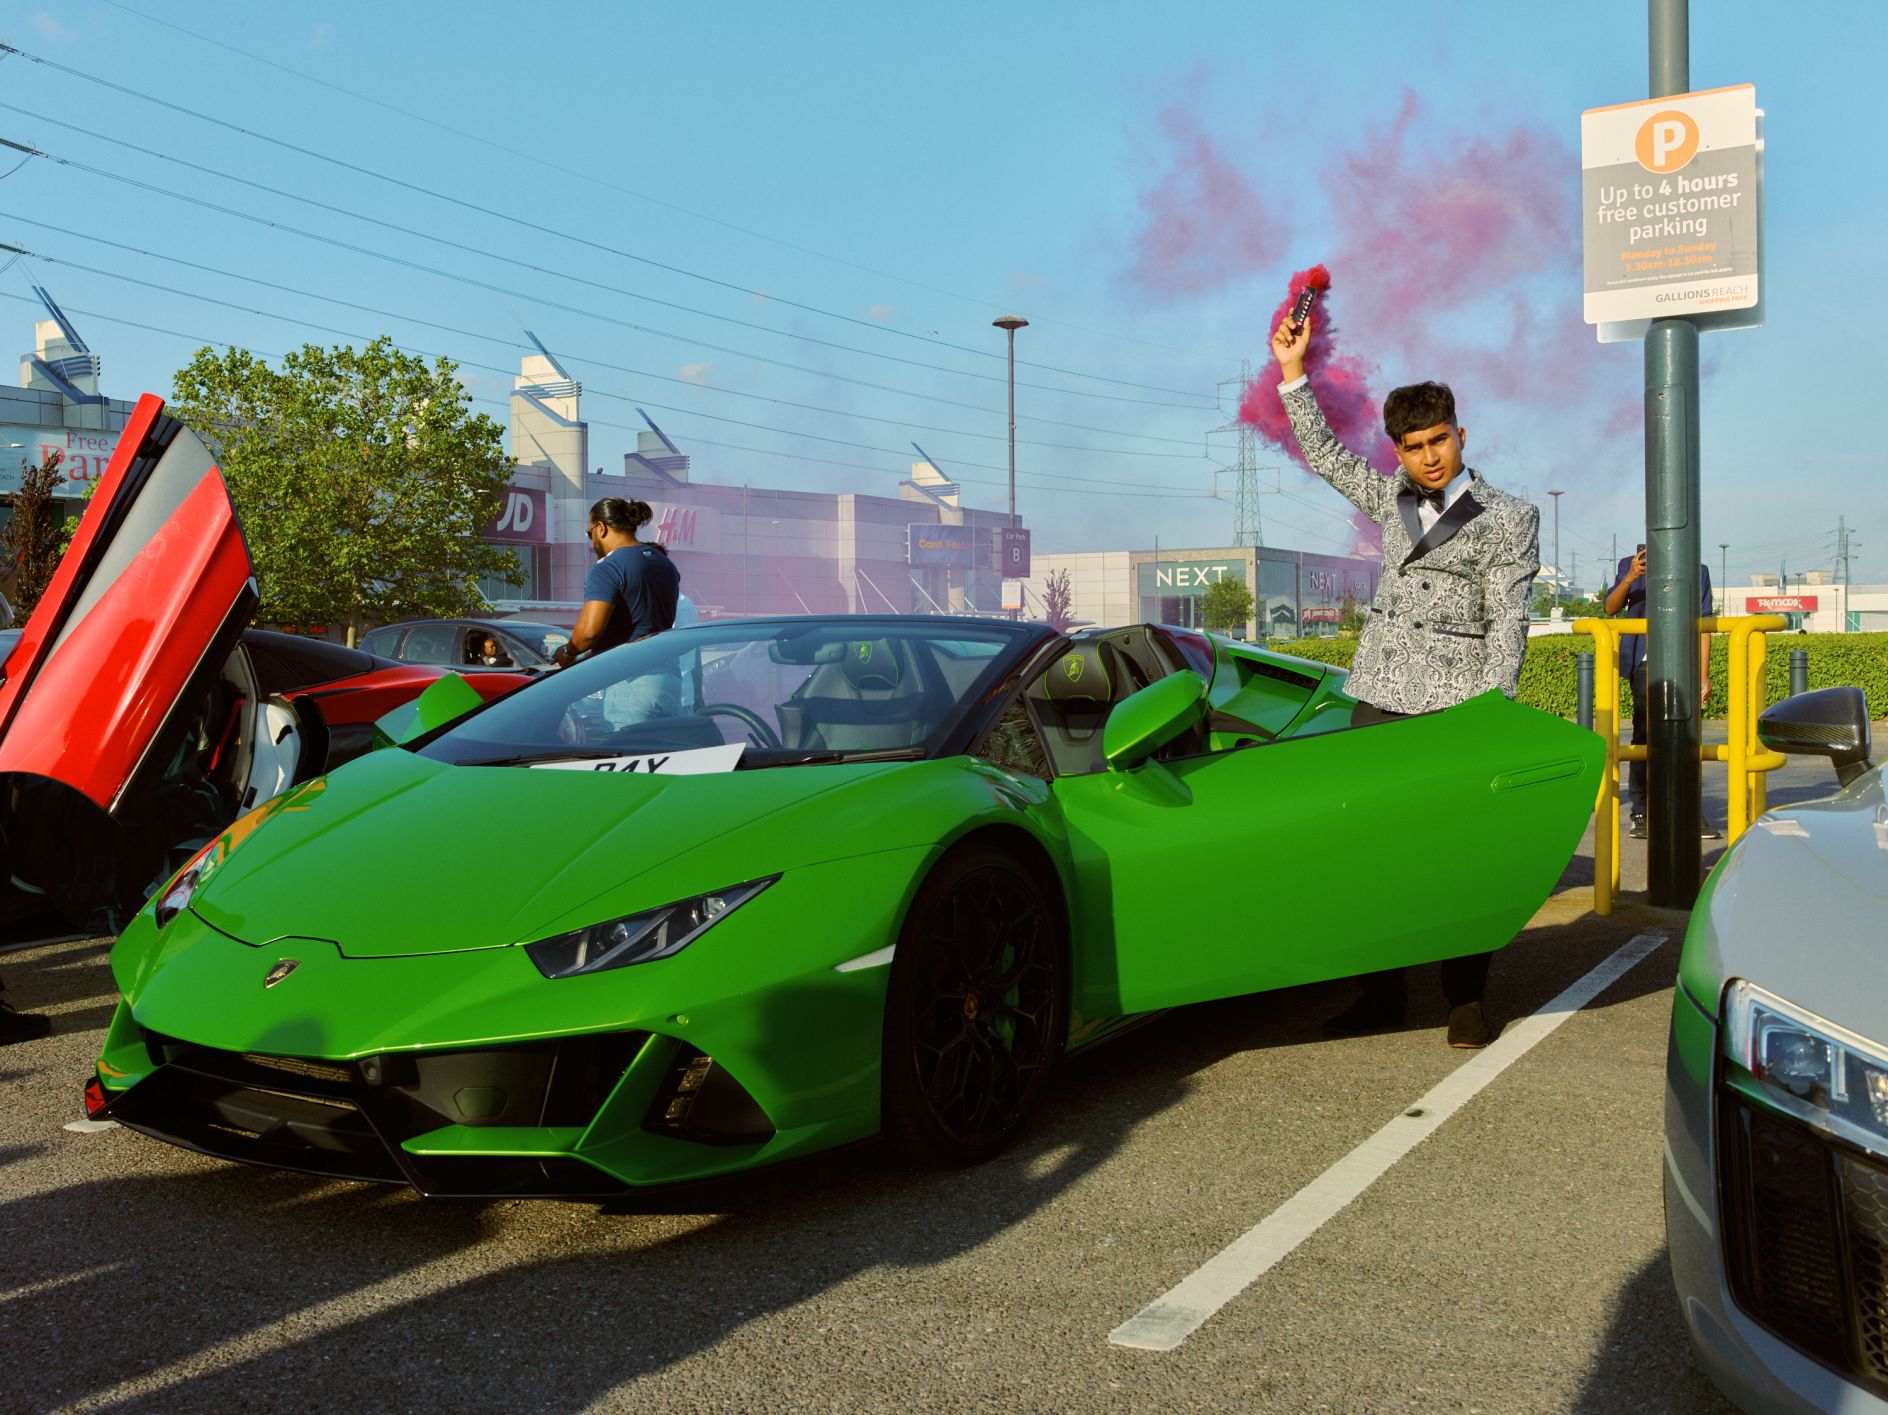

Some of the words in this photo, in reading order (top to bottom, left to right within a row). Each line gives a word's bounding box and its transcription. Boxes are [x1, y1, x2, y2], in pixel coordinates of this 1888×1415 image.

[1653, 120, 1687, 167] P
[1600, 186, 1628, 207] Up
[1633, 183, 1654, 200] to
[1659, 179, 1672, 196] 4
[1677, 172, 1739, 194] hours
[1597, 205, 1638, 224] free
[1643, 192, 1742, 218] customer
[1630, 217, 1708, 245] parking
[1622, 247, 1661, 260] Monday
[1664, 245, 1675, 256] to
[1678, 242, 1717, 254] Sunday
[1655, 288, 1711, 303] GALLIONS
[1712, 284, 1748, 297] REACH
[66, 431, 108, 451] Free
[496, 492, 534, 533] JD
[656, 507, 697, 546] H&M
[1006, 532, 1015, 540] Car
[1015, 533, 1026, 541] Park
[1012, 547, 1021, 562] B
[1156, 566, 1228, 588] NEXT
[1310, 571, 1337, 592] NEXT
